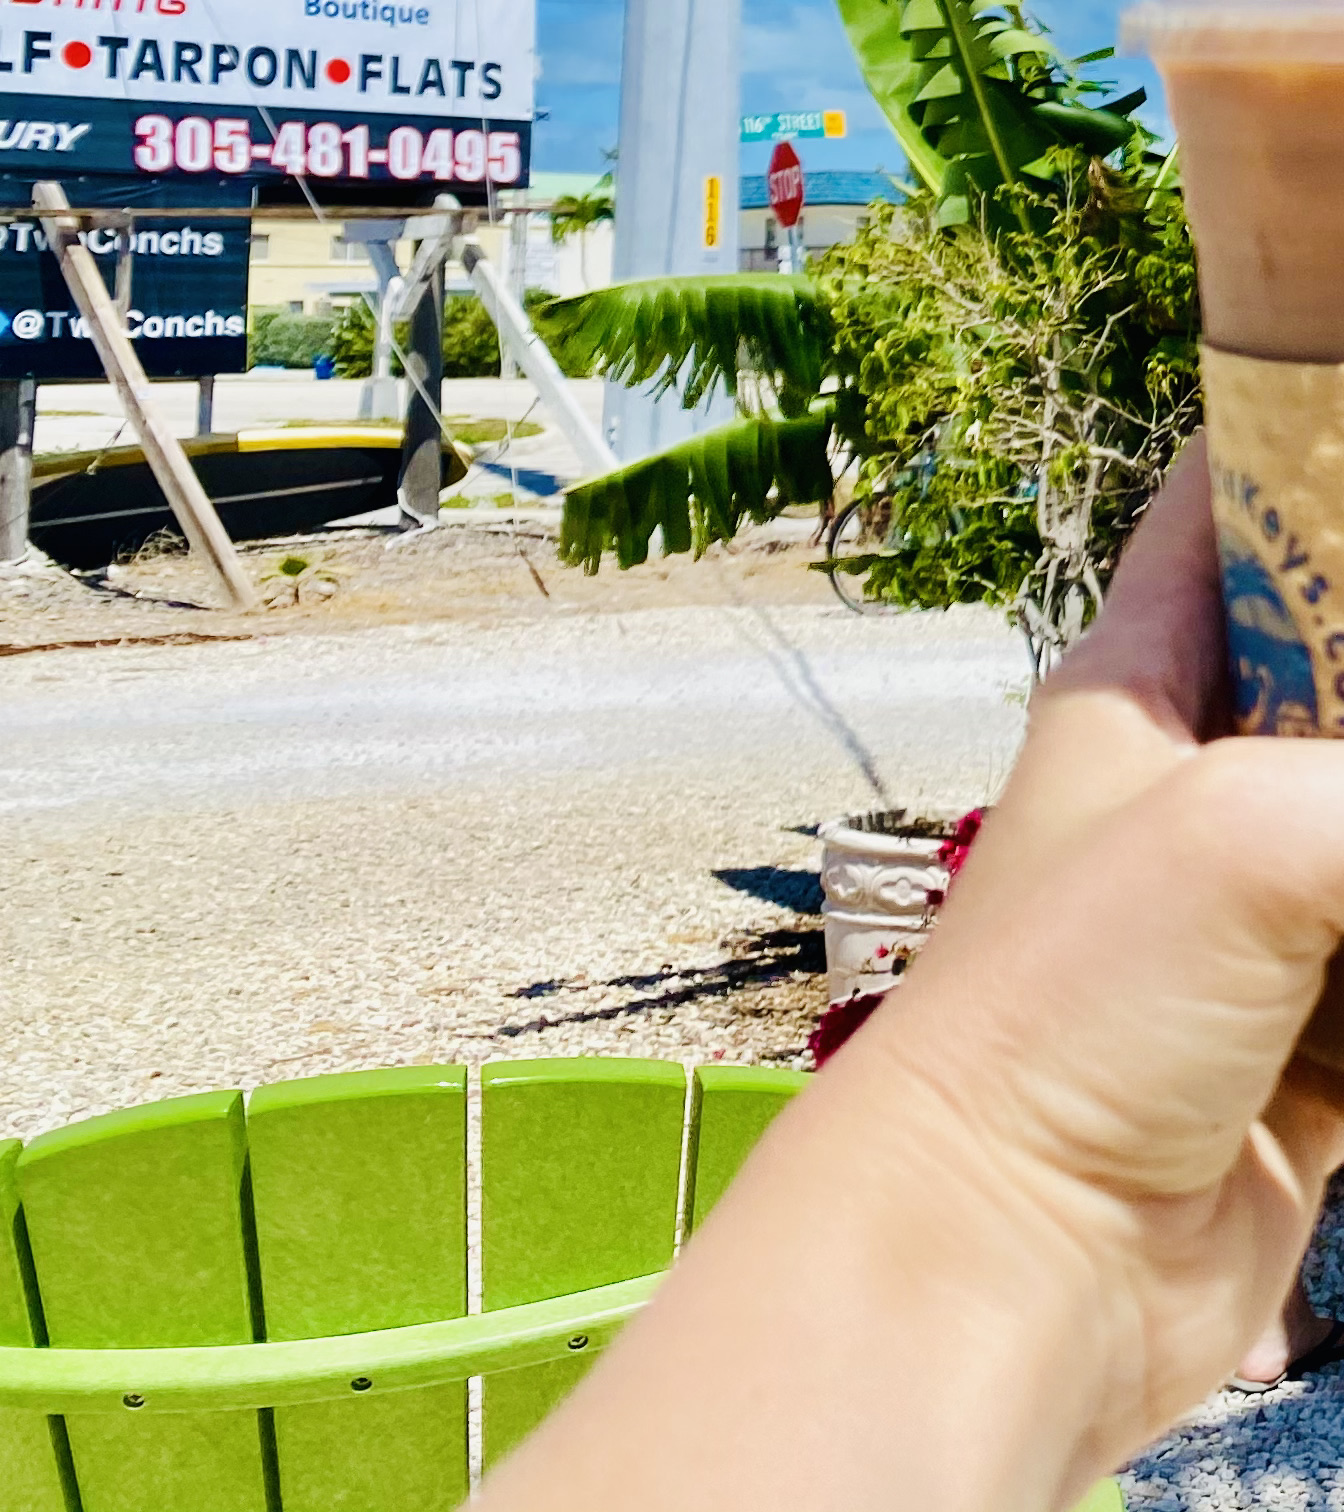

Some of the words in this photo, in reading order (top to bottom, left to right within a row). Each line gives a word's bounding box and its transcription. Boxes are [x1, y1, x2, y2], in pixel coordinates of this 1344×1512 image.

[96, 35, 319, 93] TARPON
[357, 55, 503, 101] FLATS
[778, 112, 821, 131] STREET
[132, 114, 522, 184] 305-481-0495
[769, 165, 800, 204] STOP
